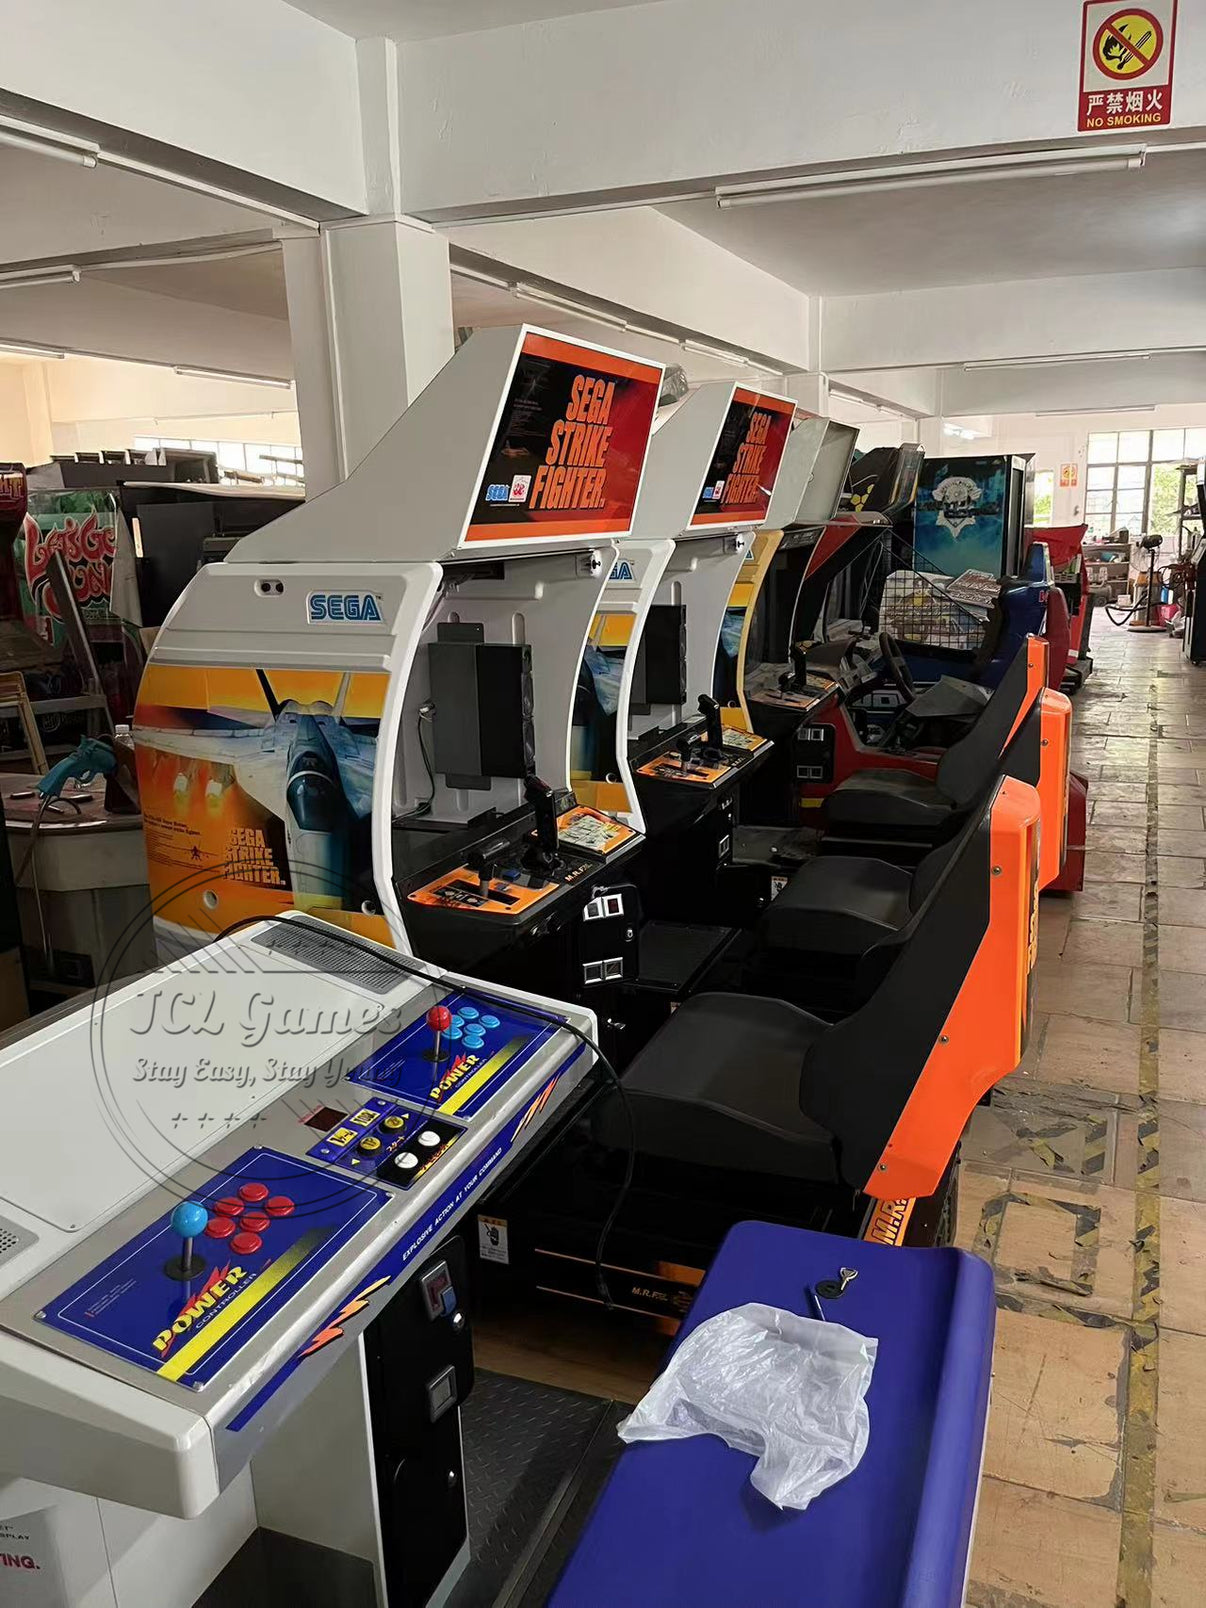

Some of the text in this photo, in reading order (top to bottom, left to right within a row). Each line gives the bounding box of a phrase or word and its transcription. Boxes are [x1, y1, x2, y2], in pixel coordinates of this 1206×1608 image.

[1086, 89, 1163, 116] 严禁烟火
[1086, 113, 1161, 128] NO SMOKING
[566, 374, 616, 425] SEGA
[545, 419, 613, 467] STRIKE
[310, 594, 381, 621] SEGA
[229, 827, 266, 848] SEGA
[429, 1054, 480, 1100] POWER
[402, 1147, 503, 1261] EXPLOSIVE ACTION AT YOUR COMMAND
[152, 1266, 248, 1351] POWER
[195, 1273, 257, 1329] CONTROLLER
